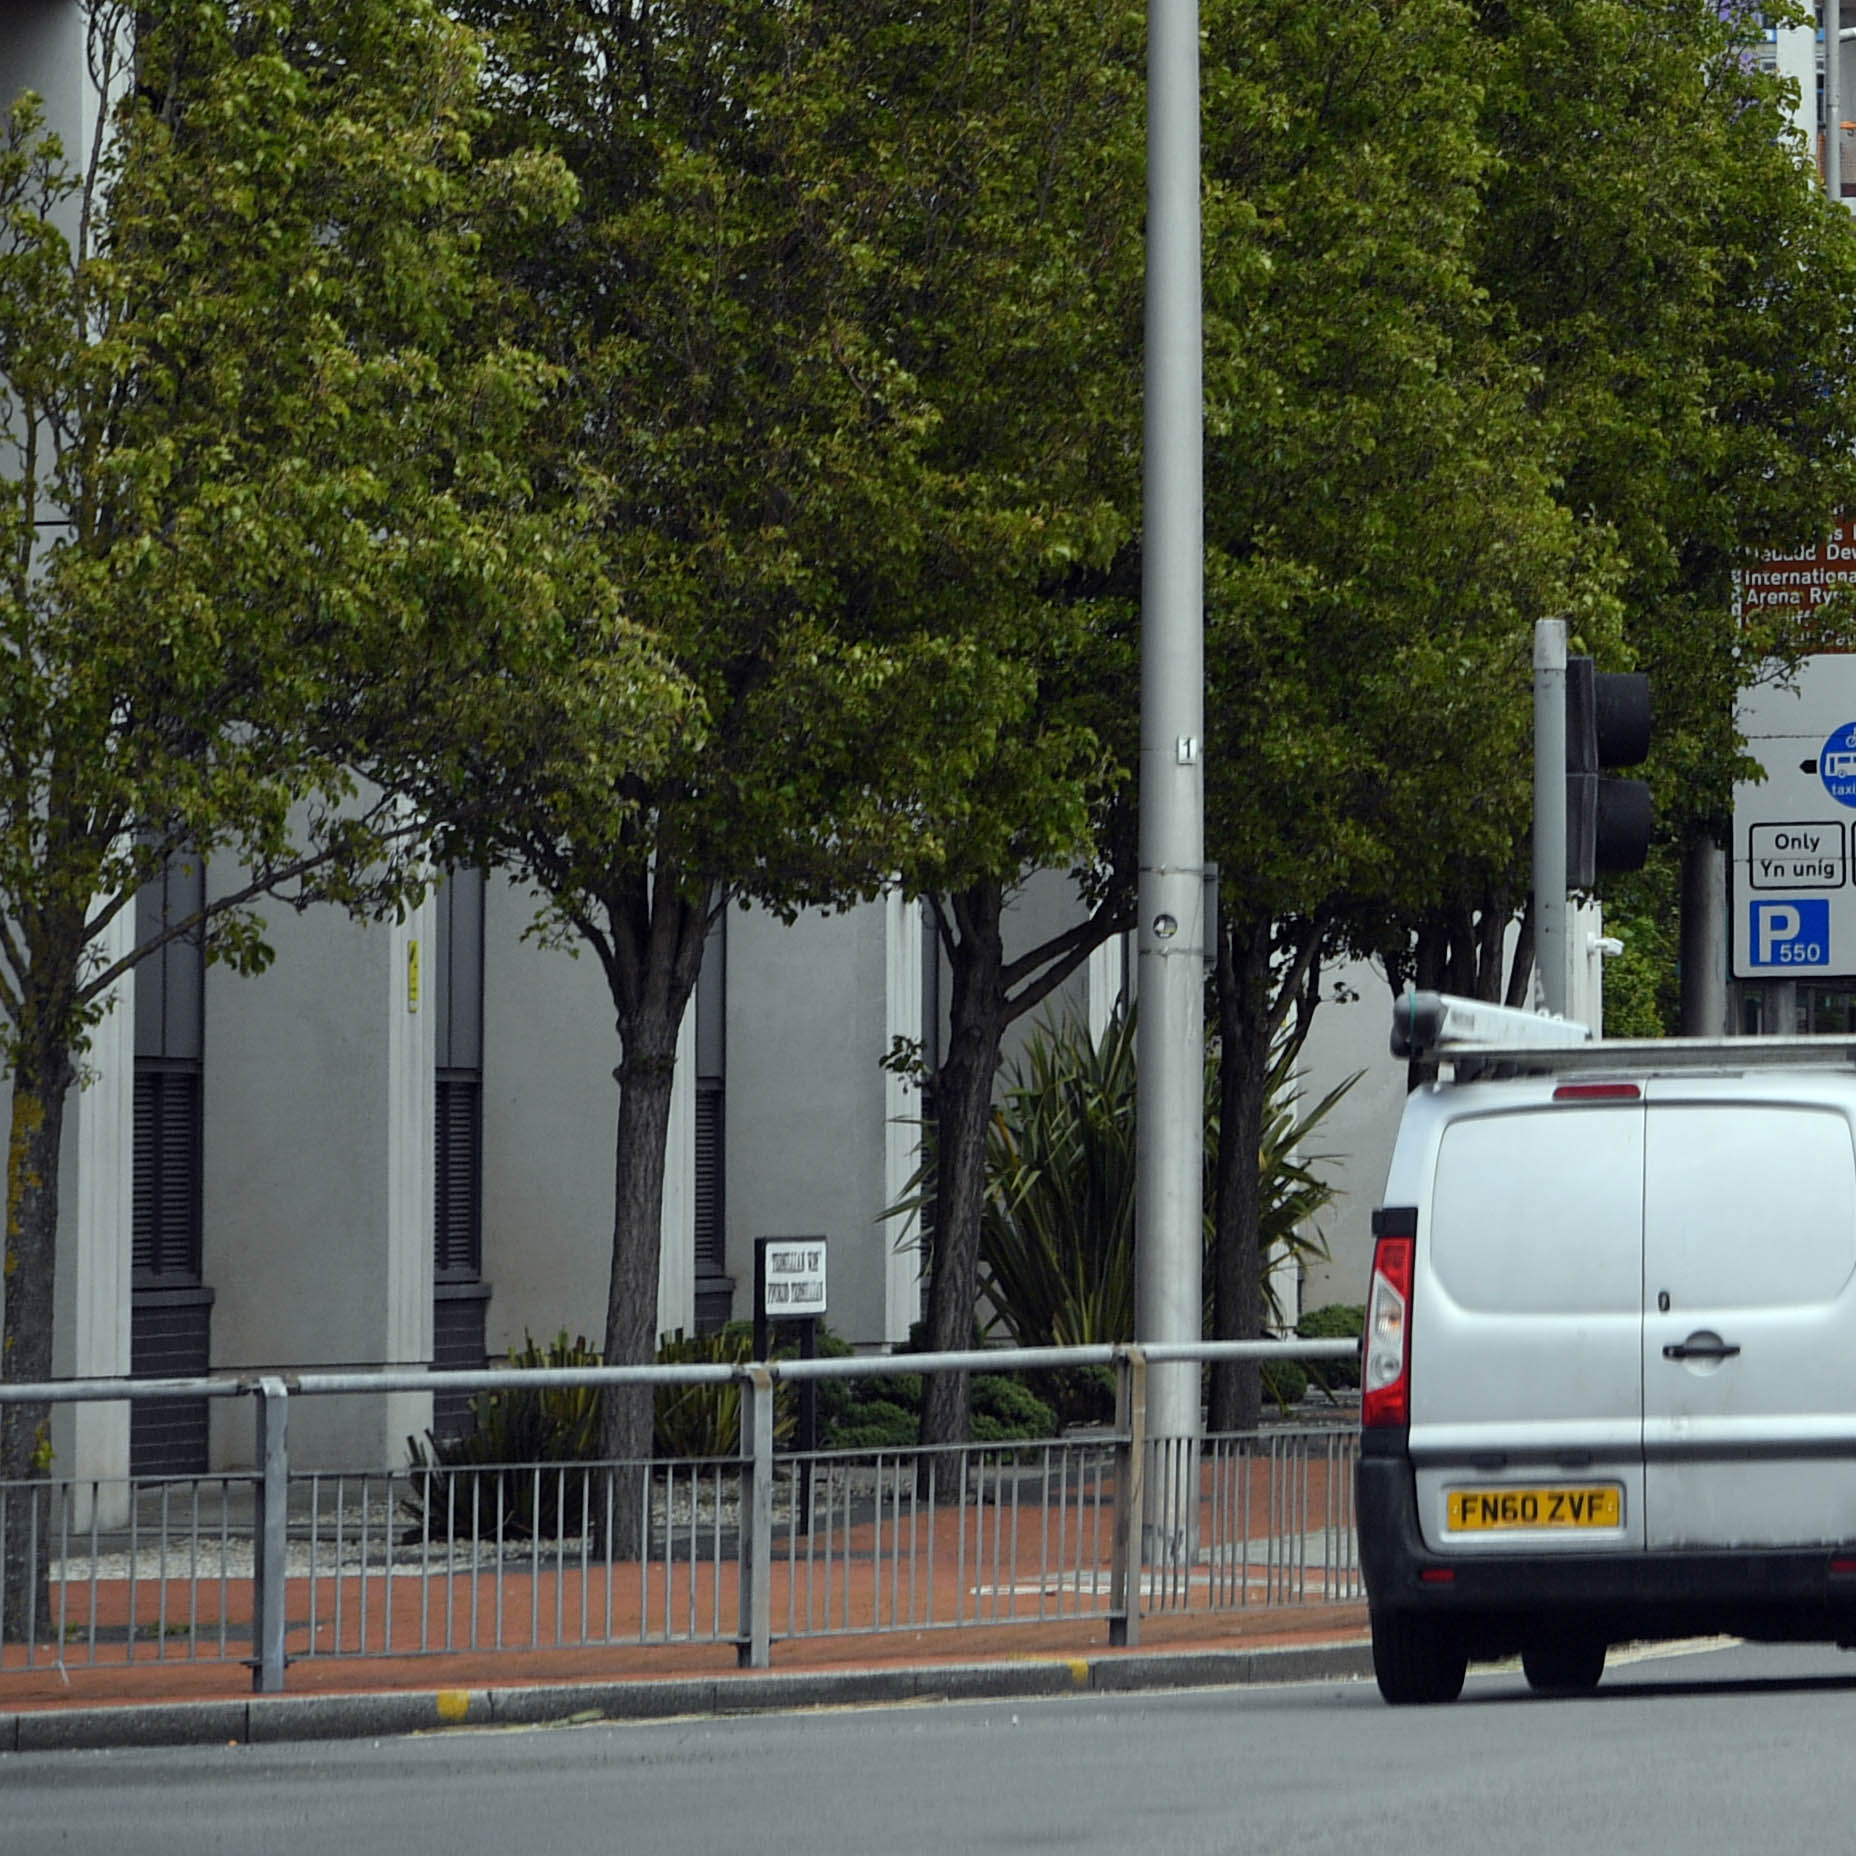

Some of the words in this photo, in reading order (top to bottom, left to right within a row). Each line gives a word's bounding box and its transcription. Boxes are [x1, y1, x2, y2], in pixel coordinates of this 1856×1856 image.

[1746, 588, 1800, 605] Arena
[1775, 833, 1820, 853] Only
[1761, 861, 1785, 877] Yn
[1759, 905, 1800, 963] P
[1779, 944, 1820, 962] 550
[1461, 1496, 1538, 1524] FN60
[1548, 1492, 1604, 1522] ZVF
